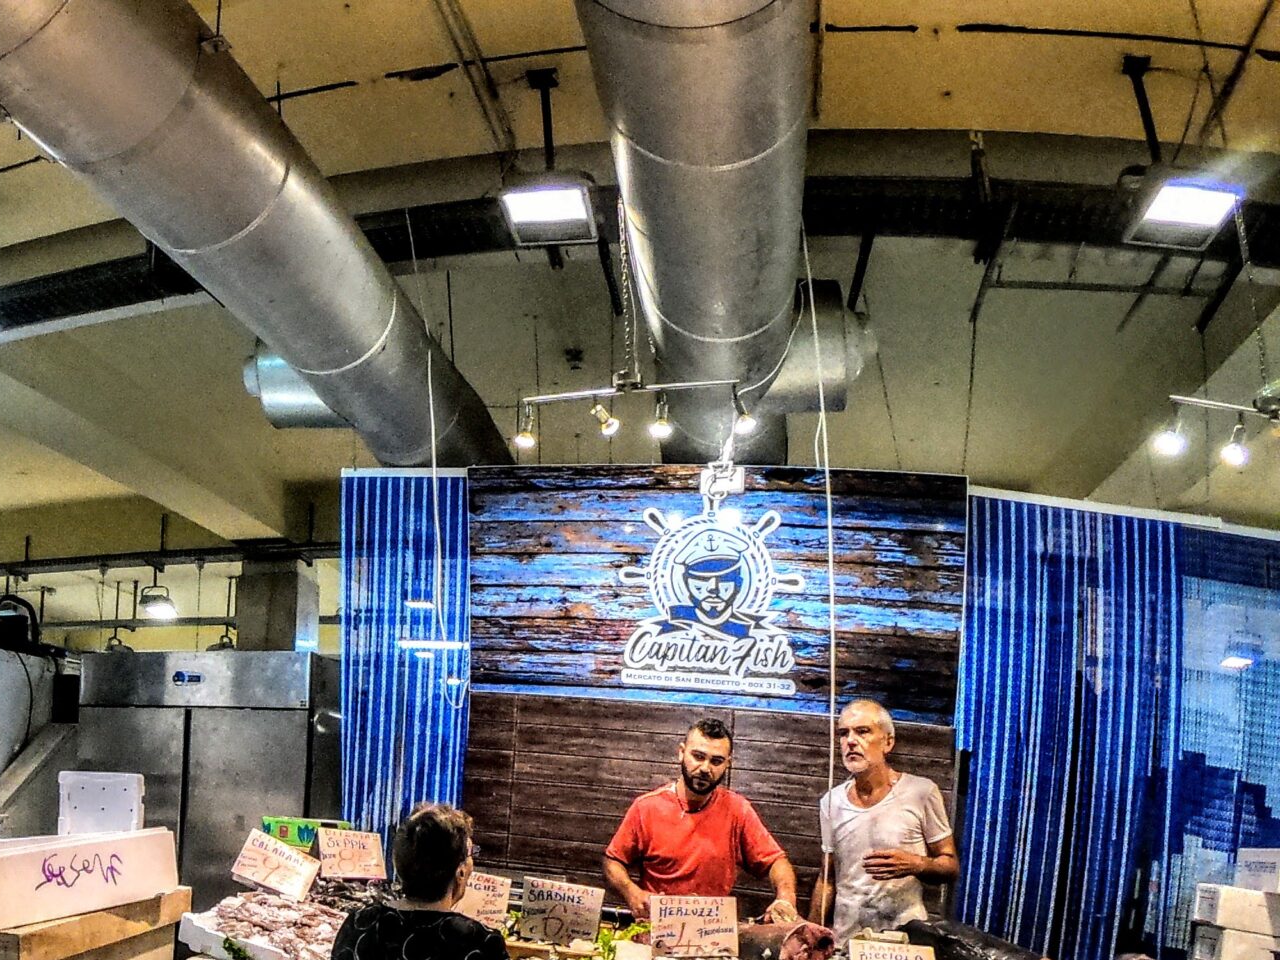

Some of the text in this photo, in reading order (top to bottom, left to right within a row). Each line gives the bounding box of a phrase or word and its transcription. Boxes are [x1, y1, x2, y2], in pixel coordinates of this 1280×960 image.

[629, 631, 789, 676] Capitan Fish
[528, 890, 585, 905] SARDINE
